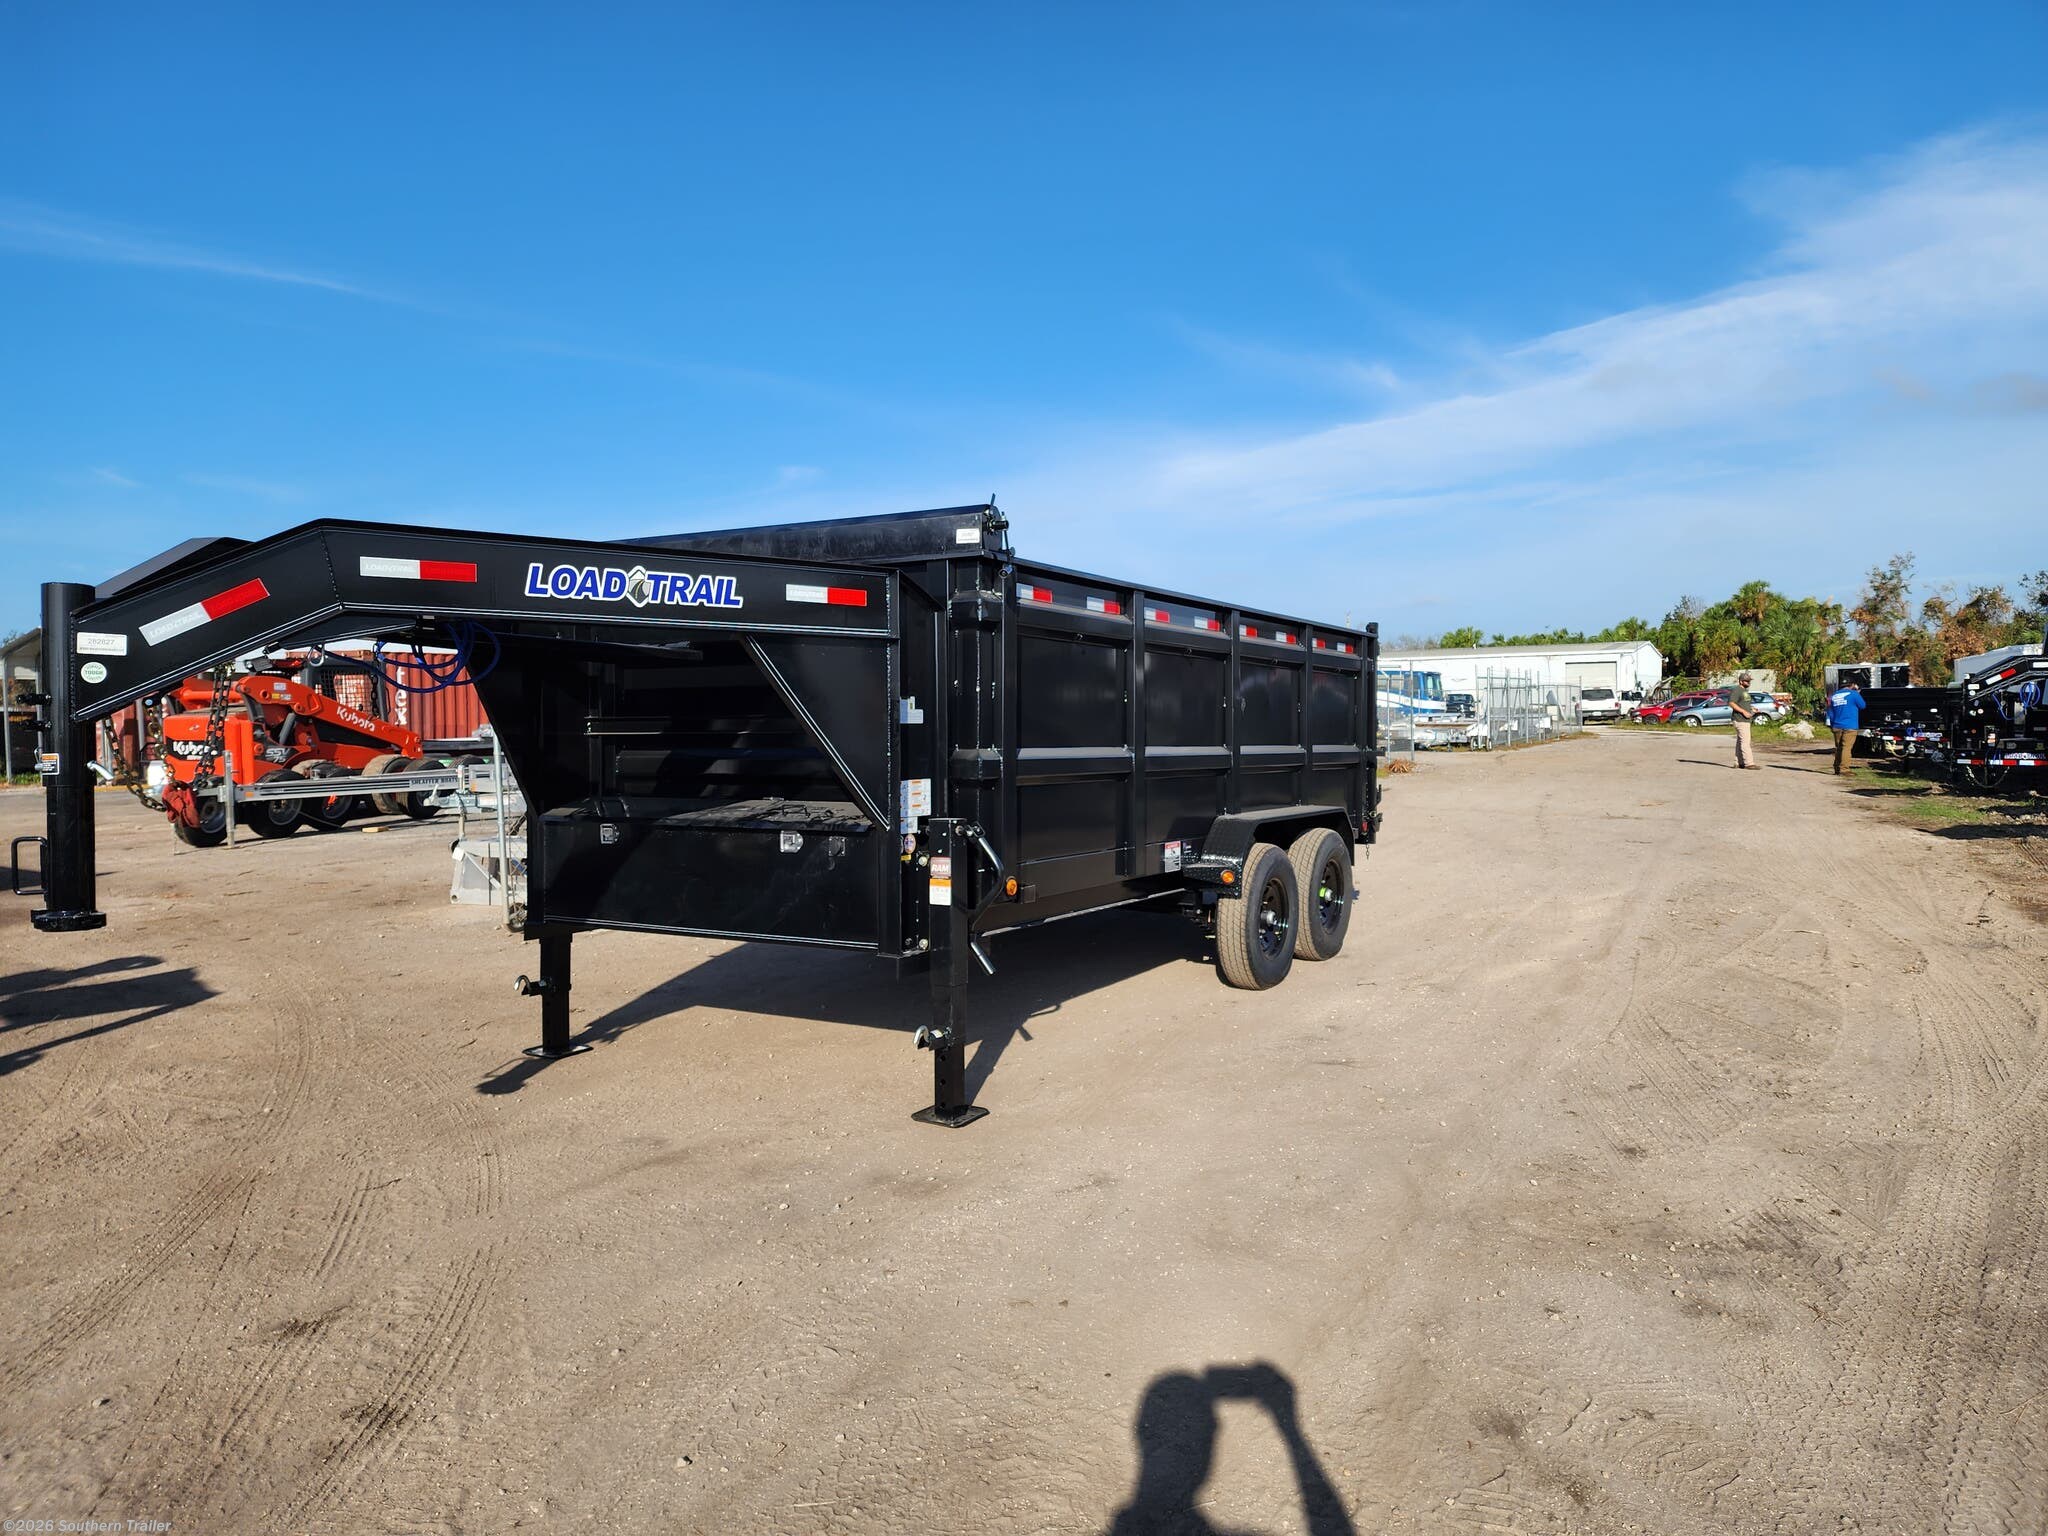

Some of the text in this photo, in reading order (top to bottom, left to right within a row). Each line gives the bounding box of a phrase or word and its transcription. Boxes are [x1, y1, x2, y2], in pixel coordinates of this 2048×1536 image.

[525, 563, 743, 608] LOAD TRAIL
[336, 705, 376, 732] Kubota
[265, 747, 290, 757] SSV
[931, 863, 949, 873] RAM
